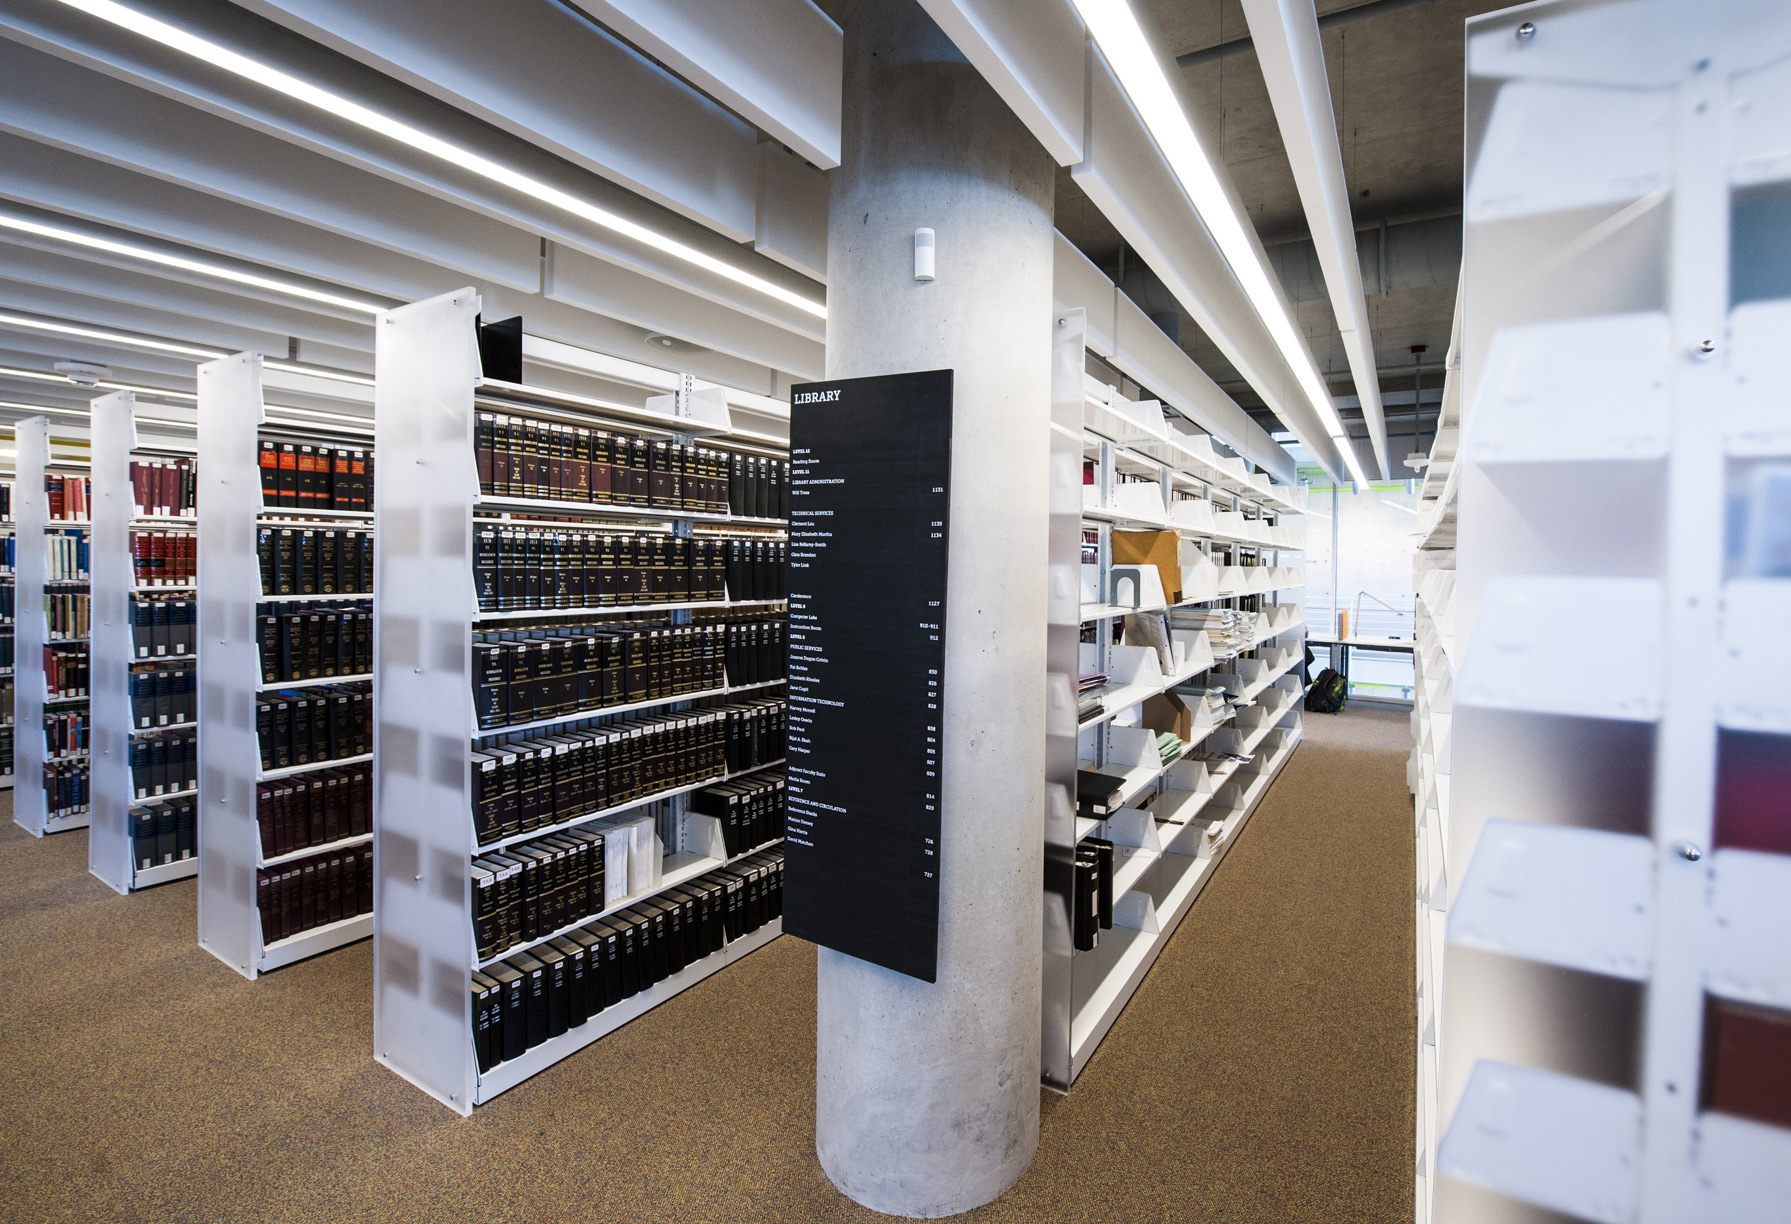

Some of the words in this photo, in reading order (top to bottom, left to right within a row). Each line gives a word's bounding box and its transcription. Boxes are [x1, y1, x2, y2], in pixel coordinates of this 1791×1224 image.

[794, 390, 841, 404] LIBRARY
[789, 695, 817, 703] INFORMATION
[817, 699, 845, 707] TECHNOLOGY
[802, 768, 816, 776] Faculty
[788, 796, 810, 805] REFERENCE
[819, 804, 847, 813] CIRCULATION
[483, 877, 493, 885] TAX
